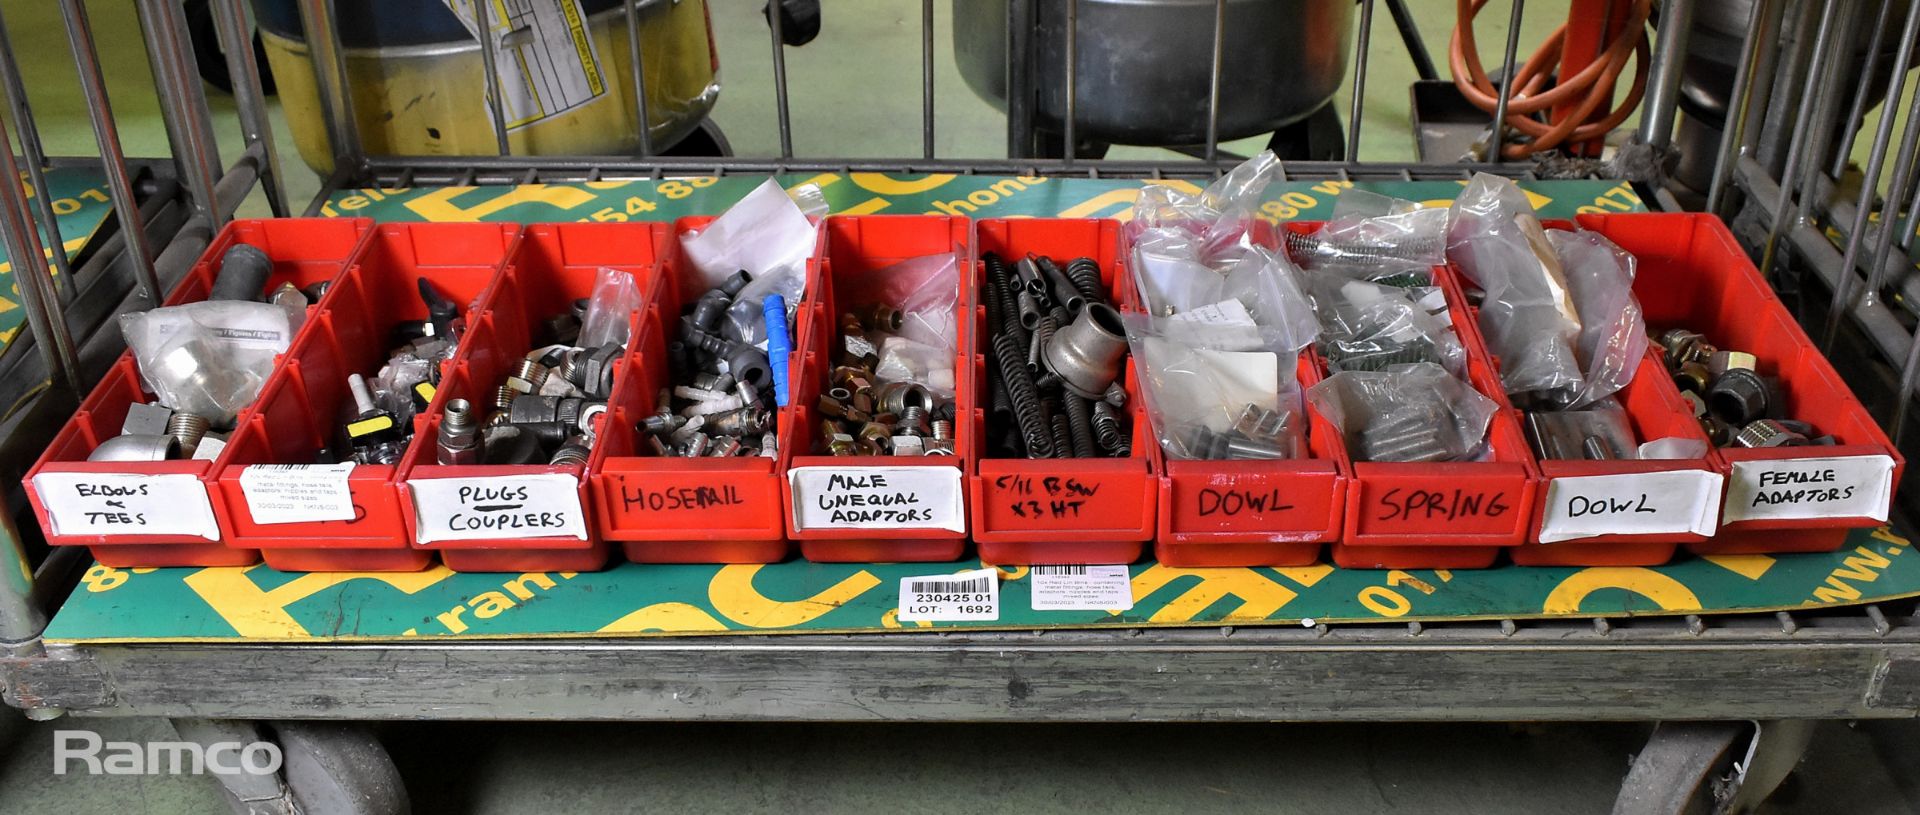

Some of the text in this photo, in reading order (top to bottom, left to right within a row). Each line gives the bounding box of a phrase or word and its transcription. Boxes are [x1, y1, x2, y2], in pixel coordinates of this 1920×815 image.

[575, 26, 594, 68] PRIORITY
[827, 473, 888, 492] MALE
[1759, 469, 1836, 488] FEMALE
[459, 486, 529, 504] PLUGS
[819, 492, 920, 511] UNEQUAL
[1199, 488, 1295, 517] DOWL
[1378, 488, 1510, 521] SPRING
[1752, 486, 1855, 508] ADAPTORS
[1568, 493, 1657, 518] DOWL
[84, 512, 147, 525] TEES
[450, 512, 566, 531] COUPLERS
[830, 508, 934, 523] ADAPTORS
[916, 594, 992, 603] 230425 01
[909, 605, 993, 614] LOT: 1692
